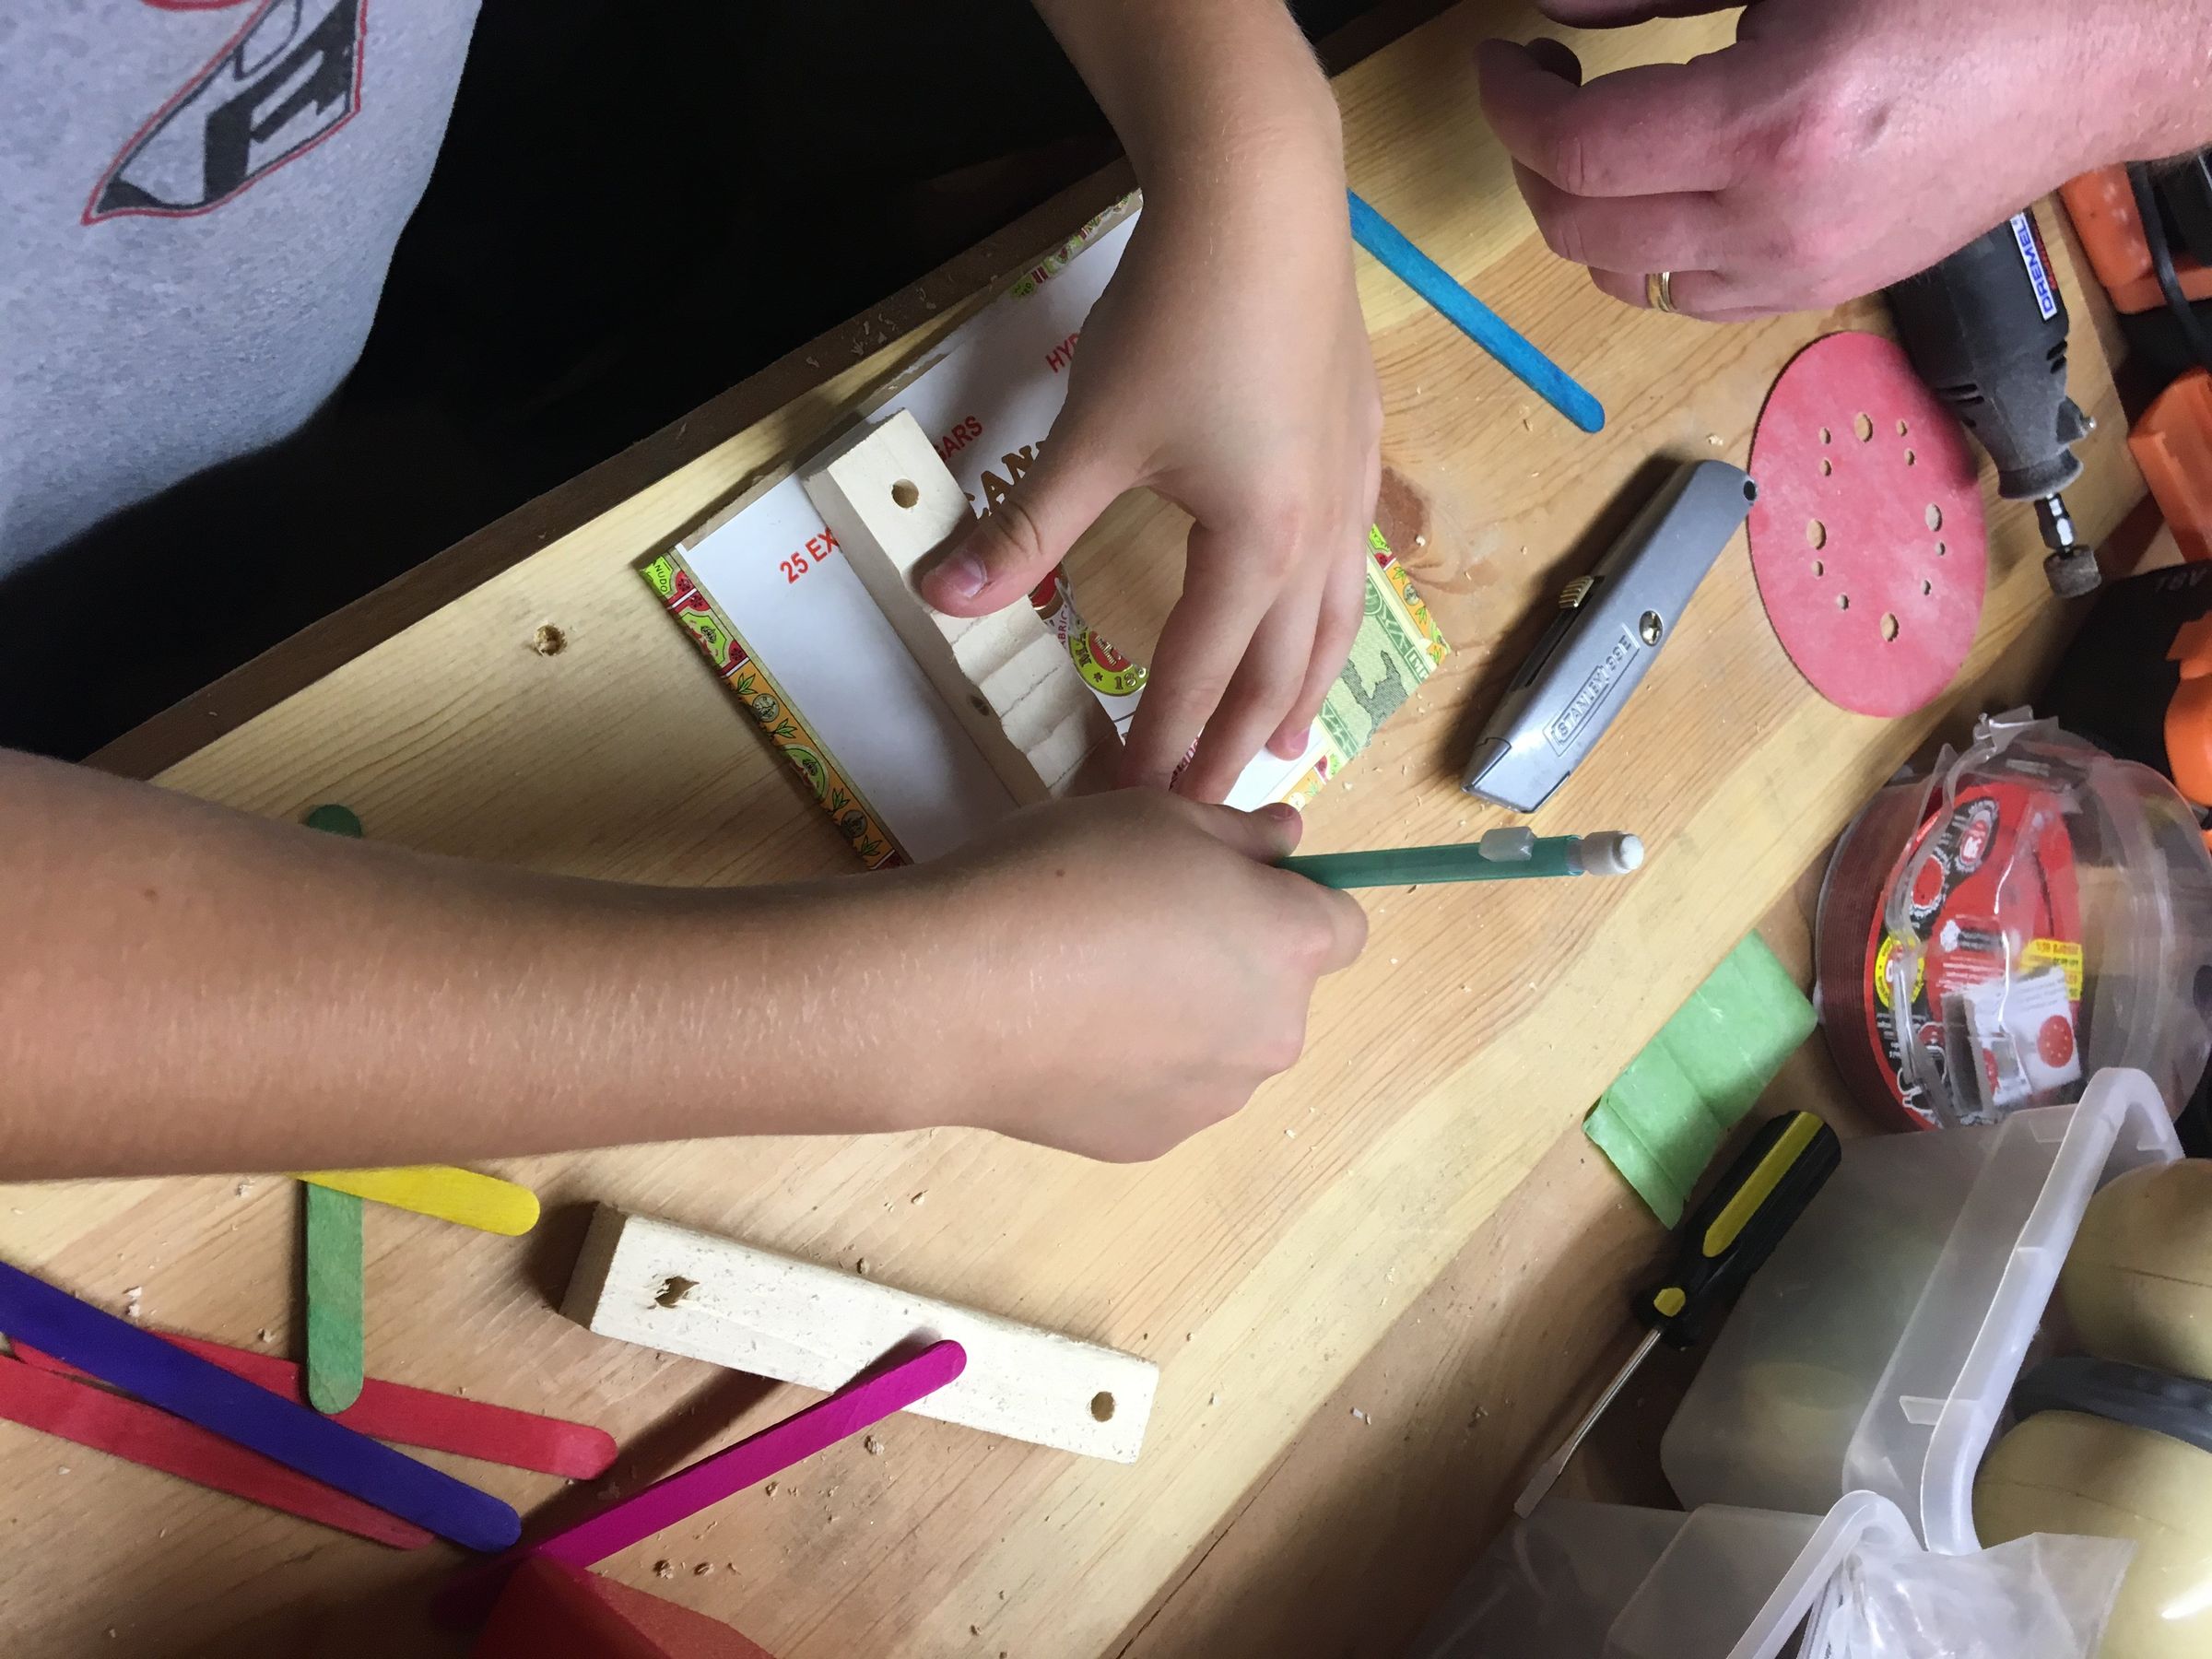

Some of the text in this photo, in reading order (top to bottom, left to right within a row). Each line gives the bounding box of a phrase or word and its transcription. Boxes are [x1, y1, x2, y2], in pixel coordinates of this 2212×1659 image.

[2018, 218, 2053, 312] DREMEL
[654, 564, 668, 593] NUDO
[780, 551, 808, 584] 25
[805, 525, 840, 562] EX
[1556, 635, 1631, 738] STANLEY 99E
